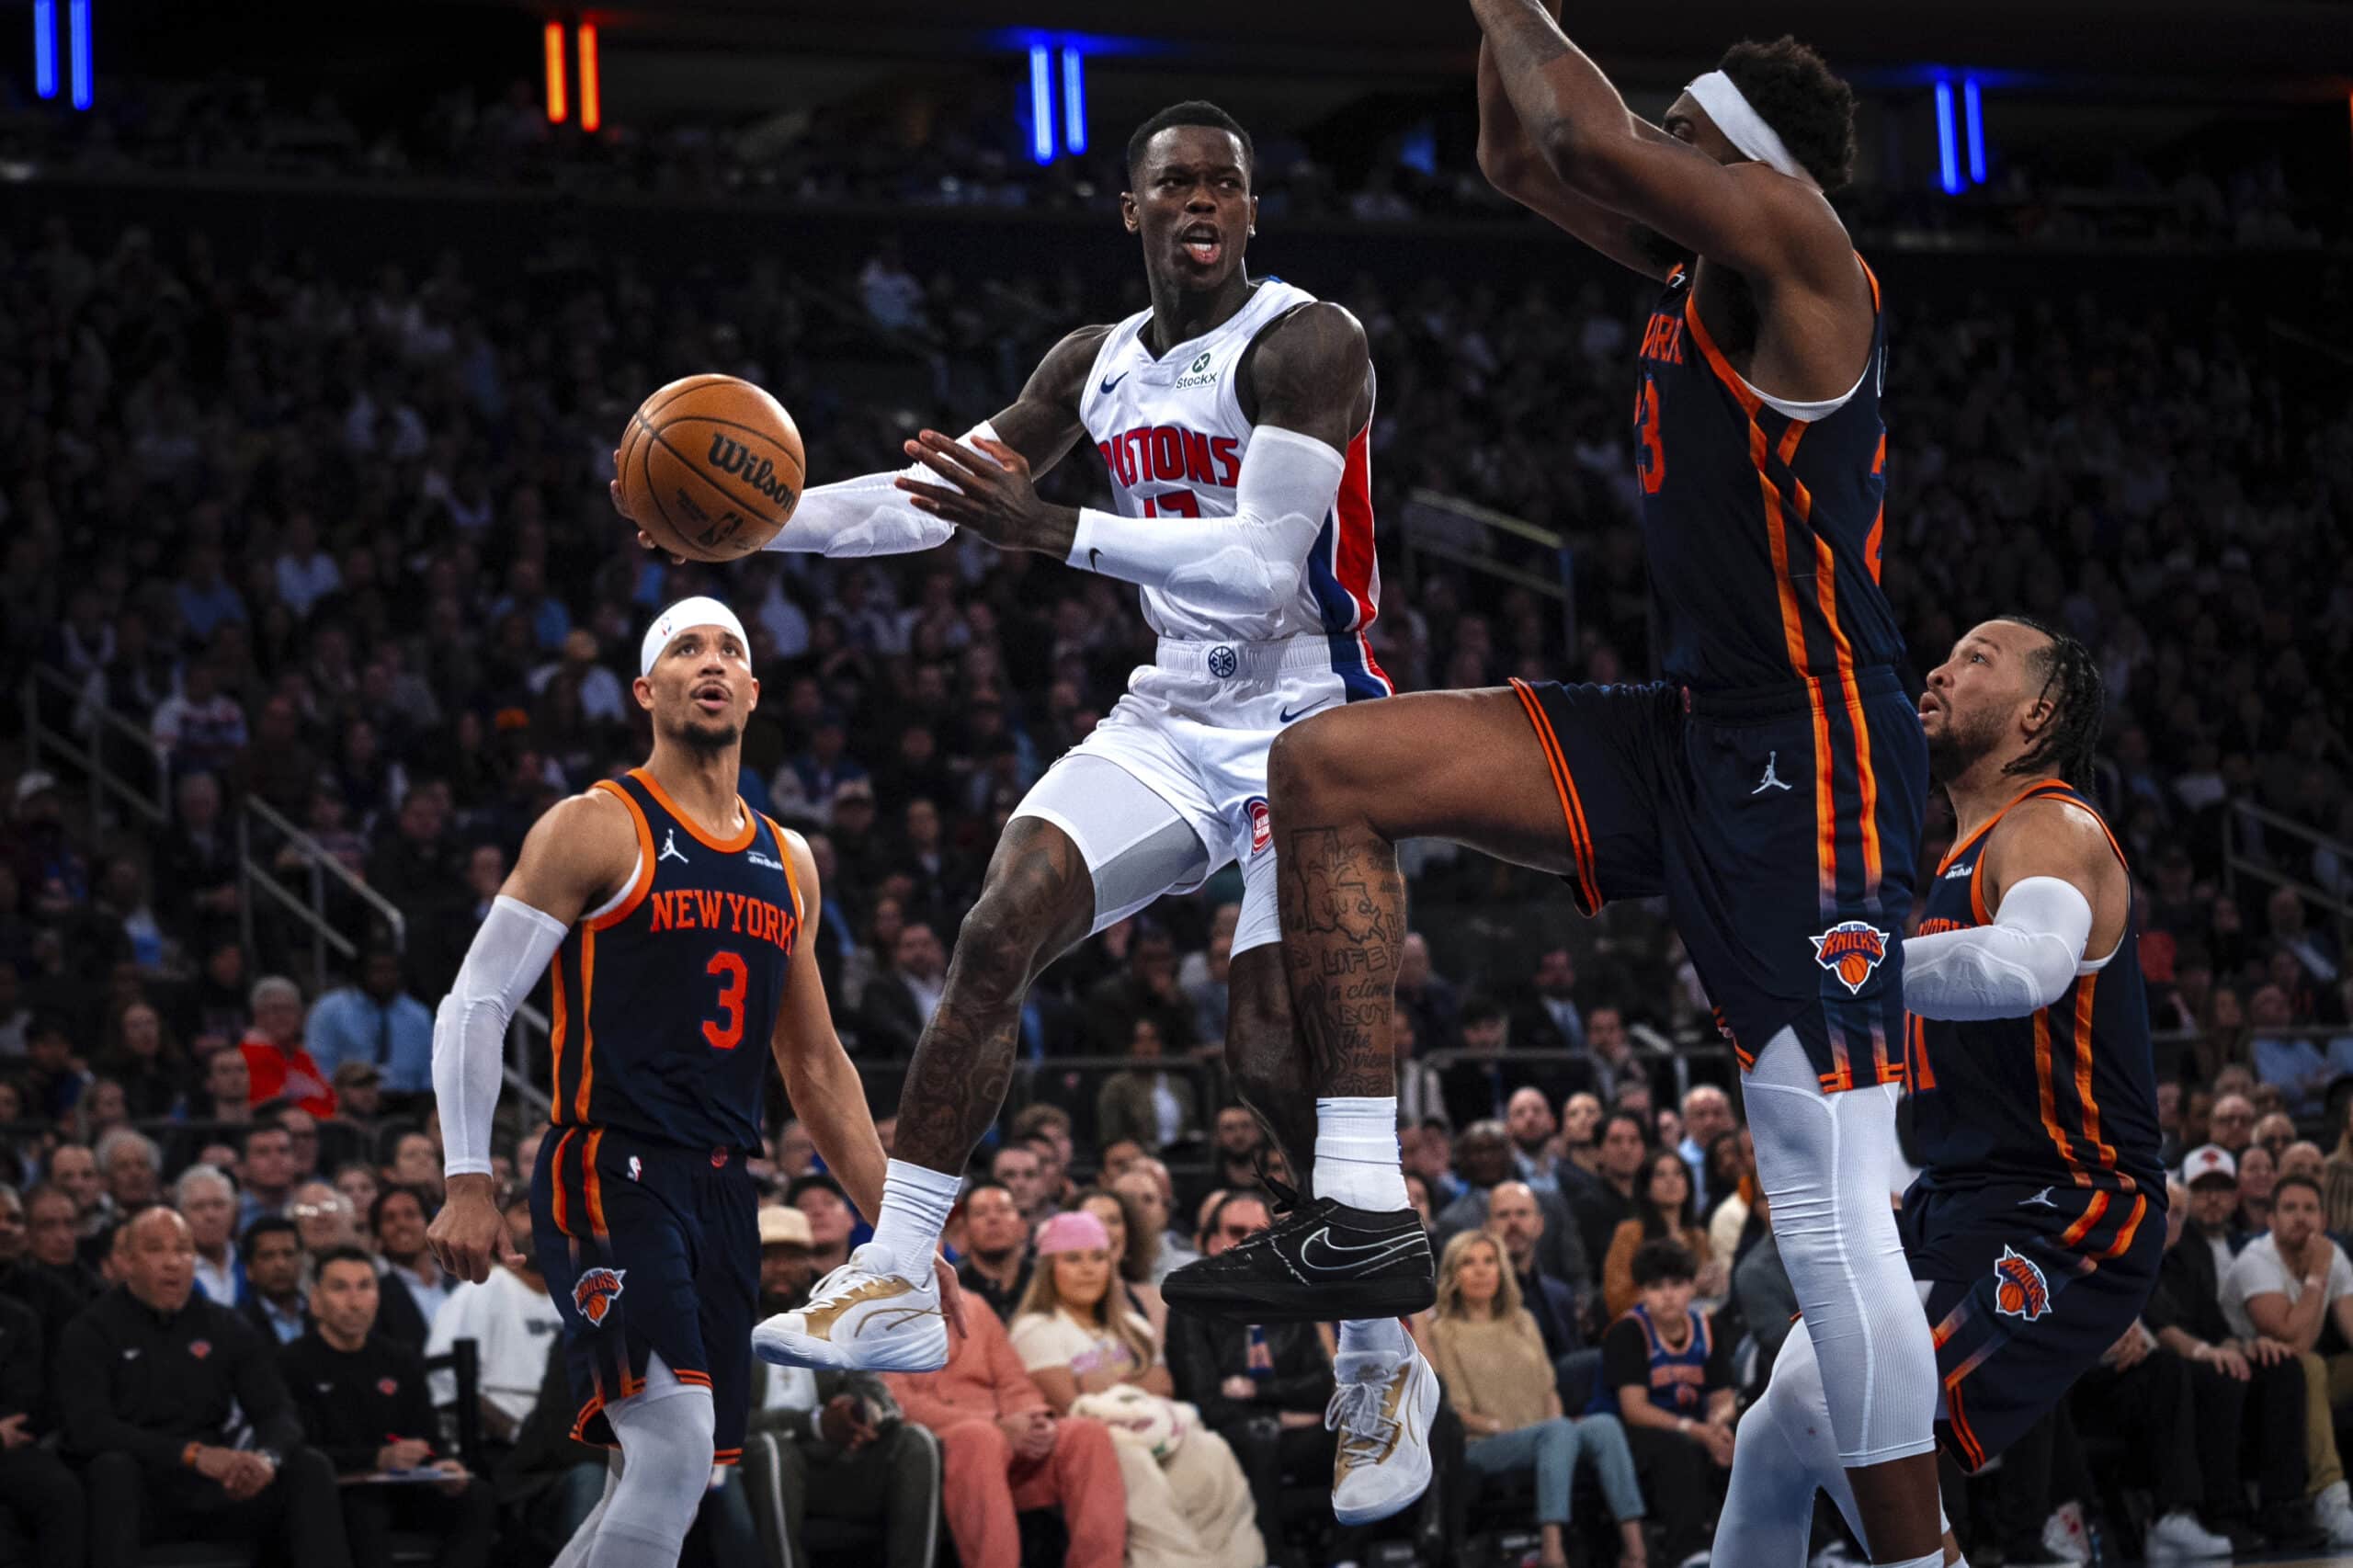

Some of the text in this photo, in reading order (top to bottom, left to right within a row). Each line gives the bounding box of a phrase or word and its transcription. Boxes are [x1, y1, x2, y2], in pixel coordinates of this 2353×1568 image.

[1176, 372, 1217, 389] StockX
[708, 432, 796, 512] Wilson
[650, 889, 796, 956] NEW YORK
[1820, 929, 1883, 960] KNICKS
[701, 949, 748, 1050] 3
